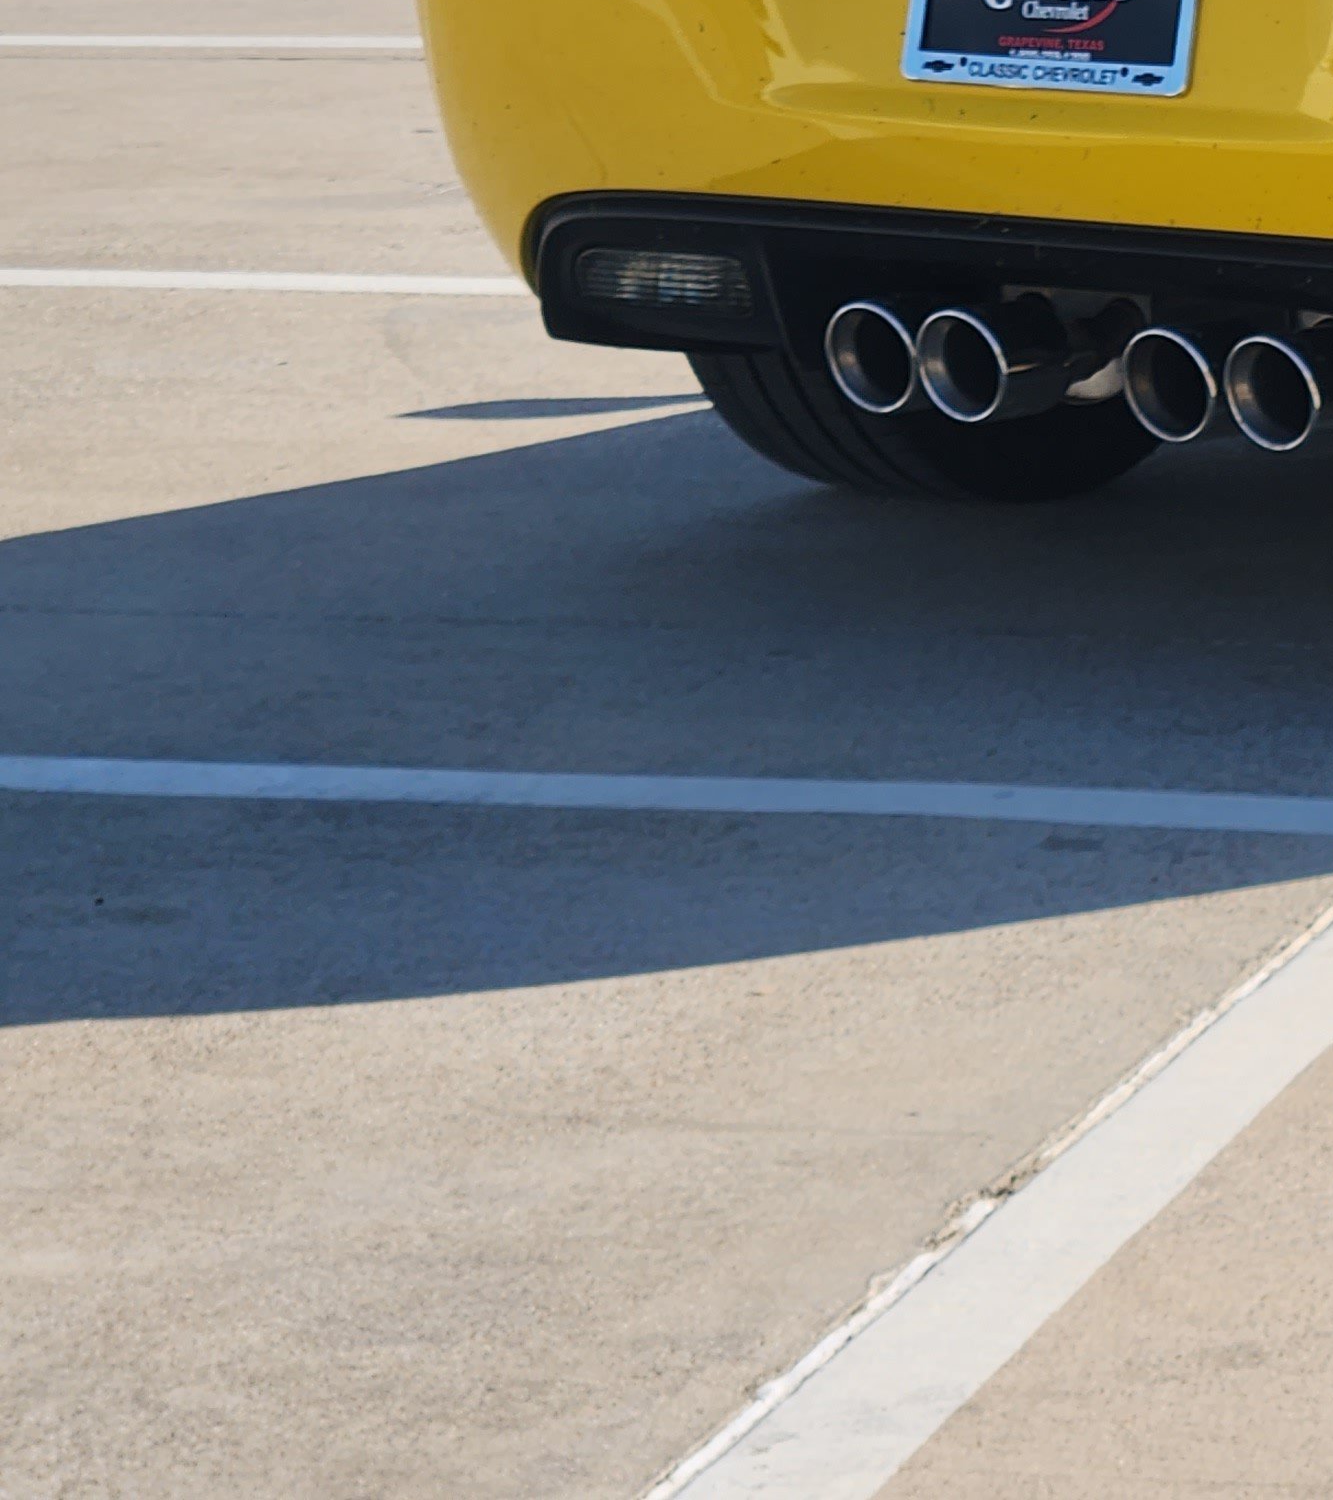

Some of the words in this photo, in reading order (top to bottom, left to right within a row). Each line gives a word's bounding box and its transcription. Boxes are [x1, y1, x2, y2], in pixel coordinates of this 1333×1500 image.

[1067, 39, 1105, 51] TEXAS
[968, 61, 1029, 79] CLASSIC
[1033, 65, 1119, 85] CHEVROLET
